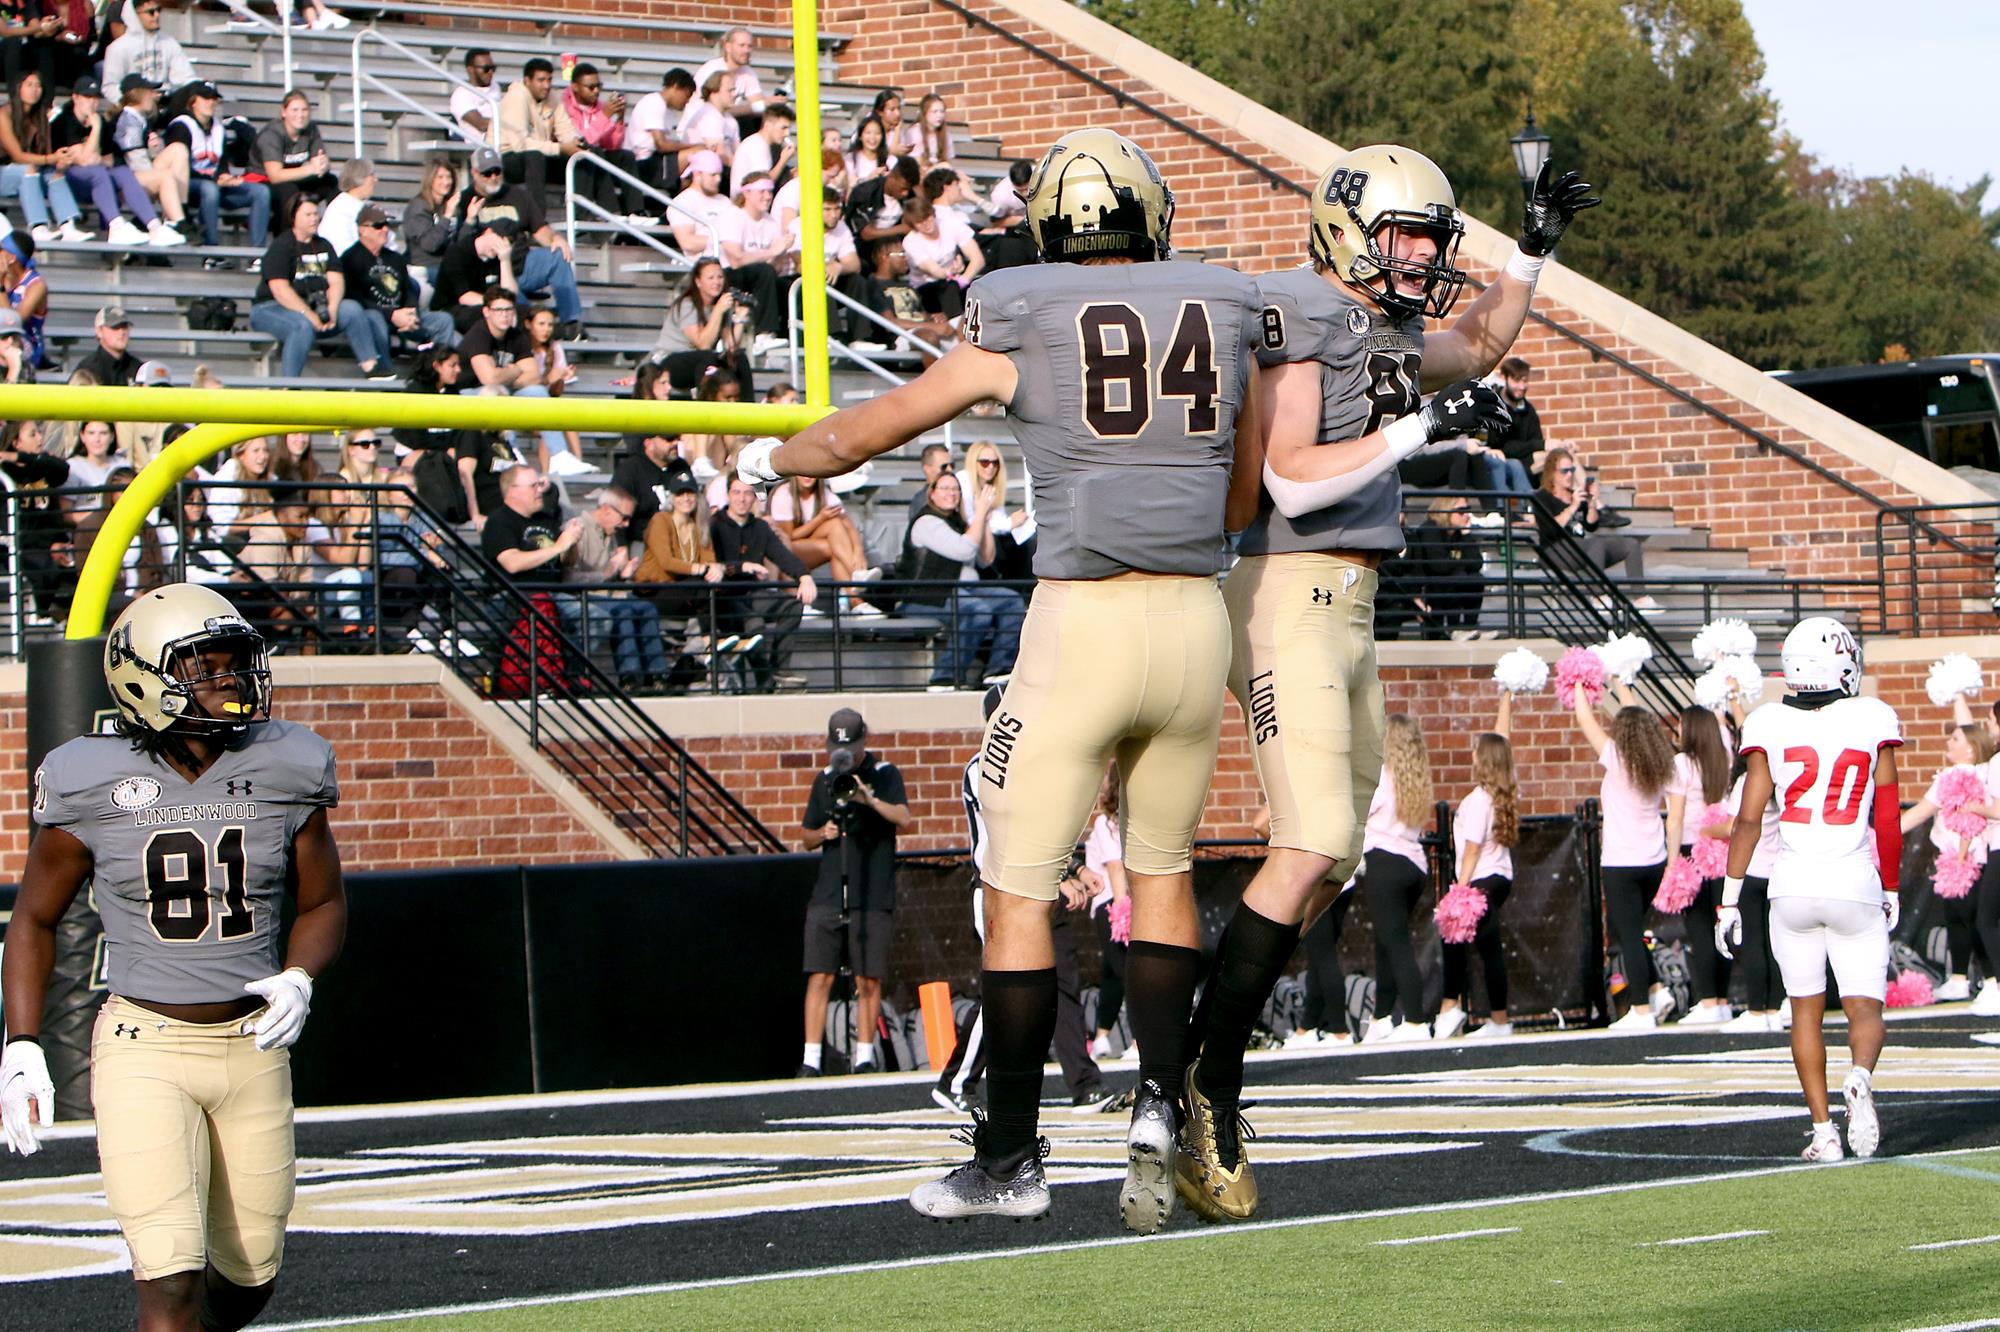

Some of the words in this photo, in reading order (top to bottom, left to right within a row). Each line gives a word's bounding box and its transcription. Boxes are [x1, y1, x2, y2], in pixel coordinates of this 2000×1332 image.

[1323, 167, 1371, 209] 88
[1062, 233, 1131, 254] LINDENWOOD
[1363, 333, 1417, 351] LINDENWOOD
[1074, 299, 1222, 440] 84
[109, 620, 134, 671] 81
[1830, 632, 1856, 656] 20
[1246, 670, 1279, 746] LIONS
[835, 727, 851, 742] L
[981, 711, 1023, 790] LIONS
[120, 783, 152, 803] OVC
[1779, 745, 1872, 826] 20
[134, 802, 258, 827] LINDENWOOD
[142, 825, 256, 943] 81
